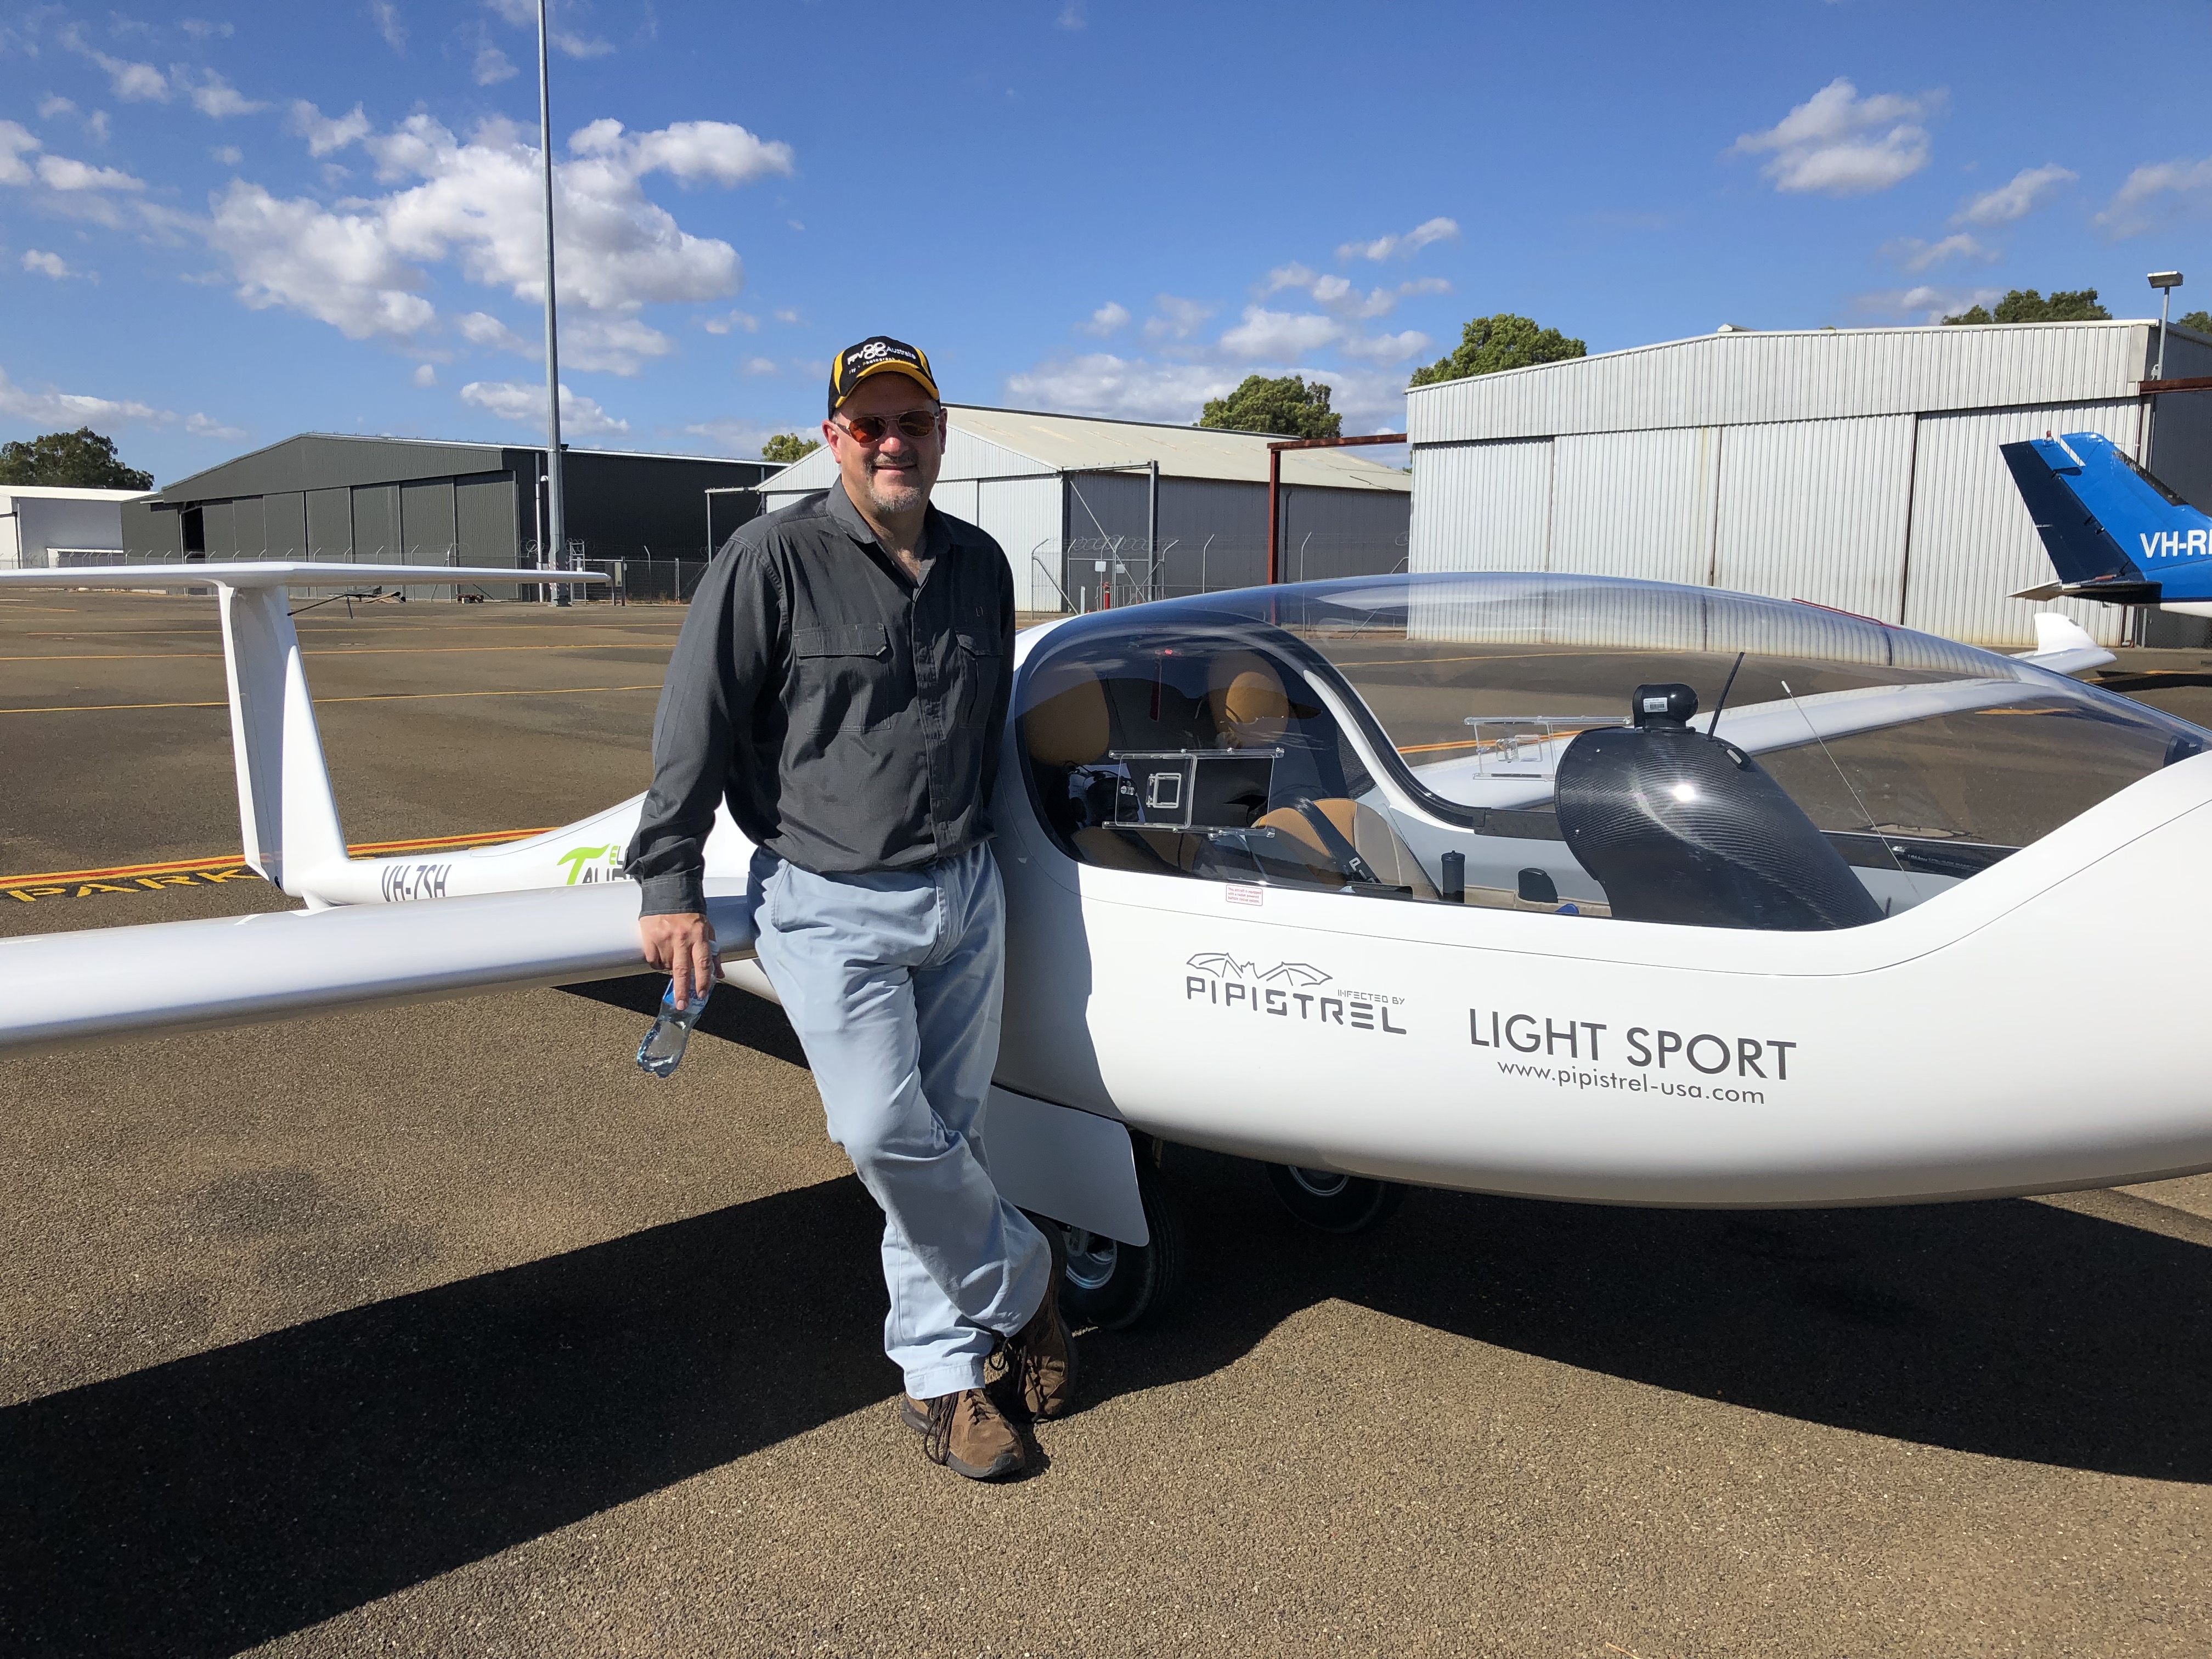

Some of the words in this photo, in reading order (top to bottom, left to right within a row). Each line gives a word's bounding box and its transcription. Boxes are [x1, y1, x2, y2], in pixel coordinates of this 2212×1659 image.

[2140, 529, 2212, 558] VH-R
[609, 845, 625, 865] EL
[1186, 976, 1407, 1035] PIPISTREL
[1338, 989, 1389, 1003] INFECTED
[1392, 996, 1405, 1005] BY
[1469, 1008, 1607, 1061] LIGHT
[1626, 1027, 1797, 1081] SPORT
[1497, 1061, 1765, 1104] www.pipistrel-usa.com
